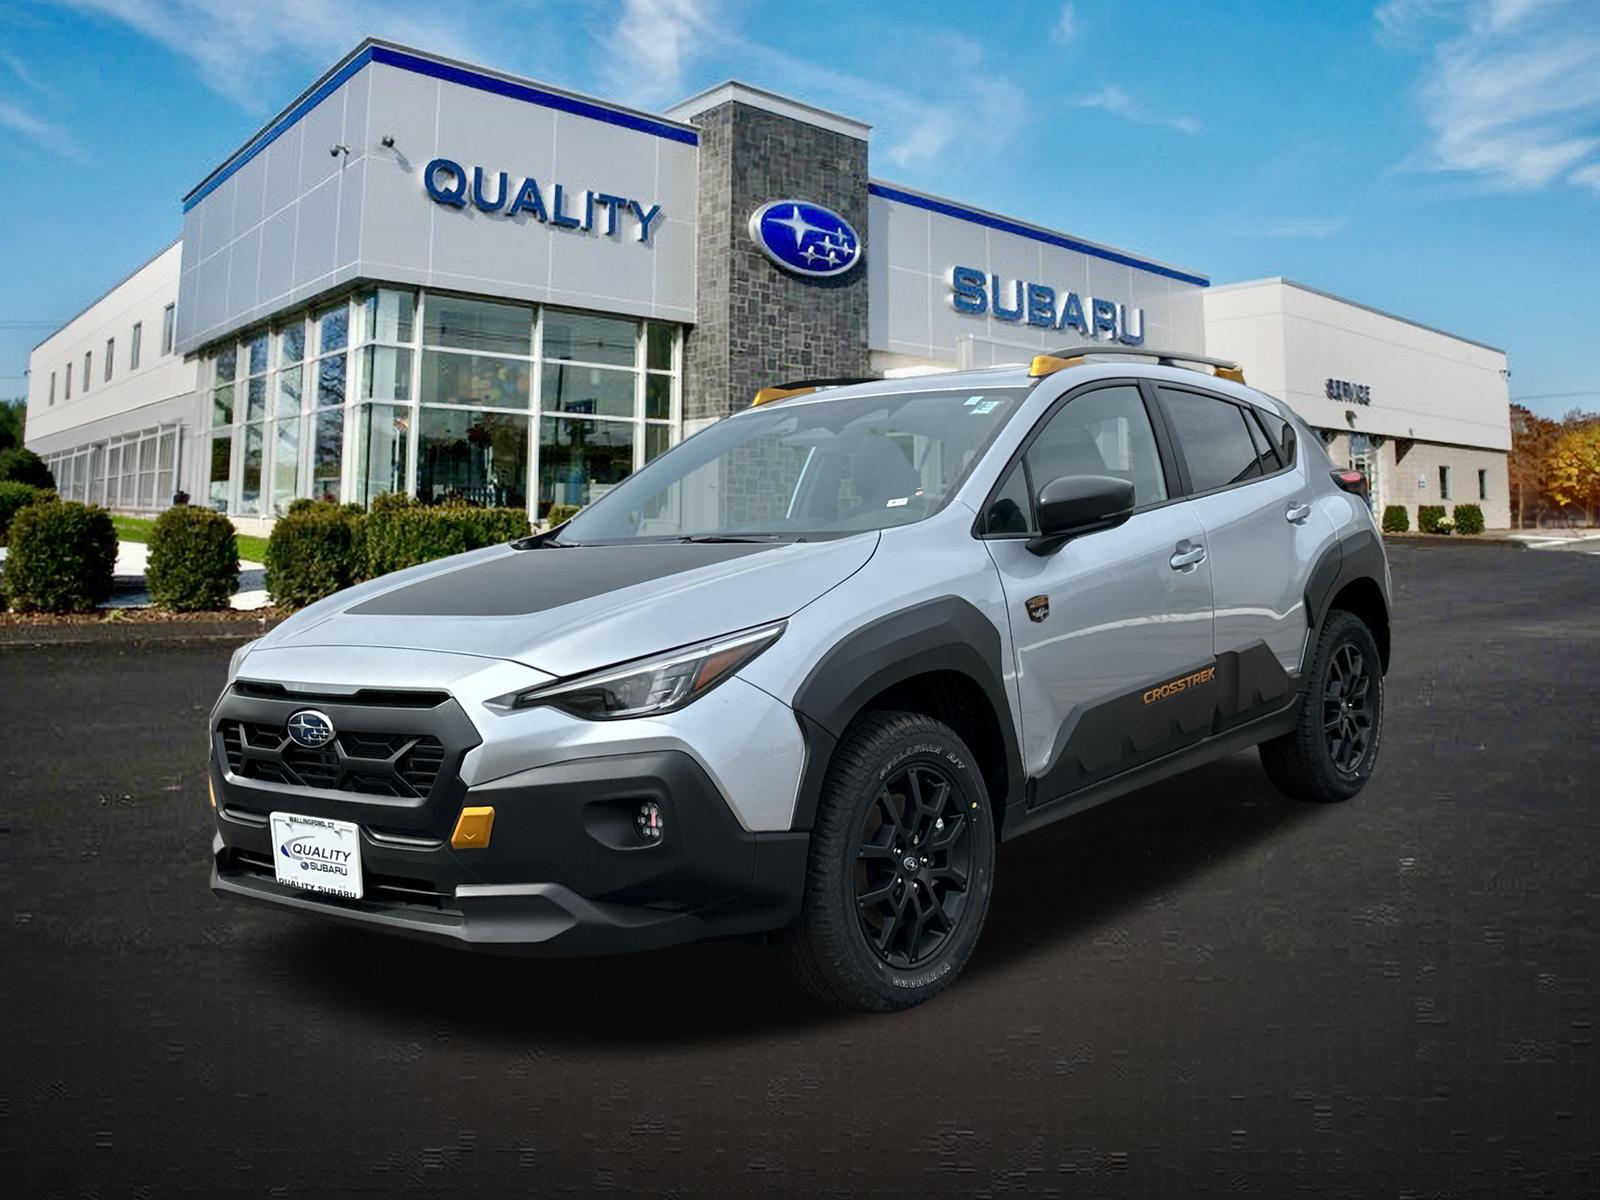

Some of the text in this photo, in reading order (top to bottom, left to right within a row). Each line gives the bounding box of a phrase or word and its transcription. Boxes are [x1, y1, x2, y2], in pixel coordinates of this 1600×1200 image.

[423, 158, 662, 243] QUALITY
[949, 265, 1145, 347] SUBARU
[1325, 378, 1371, 407] SERVICE
[1143, 666, 1216, 705] CROSSTREK
[292, 843, 352, 862] QUALITY
[309, 861, 348, 876] SUBARU
[278, 877, 357, 899] QUALITY SUBARU
